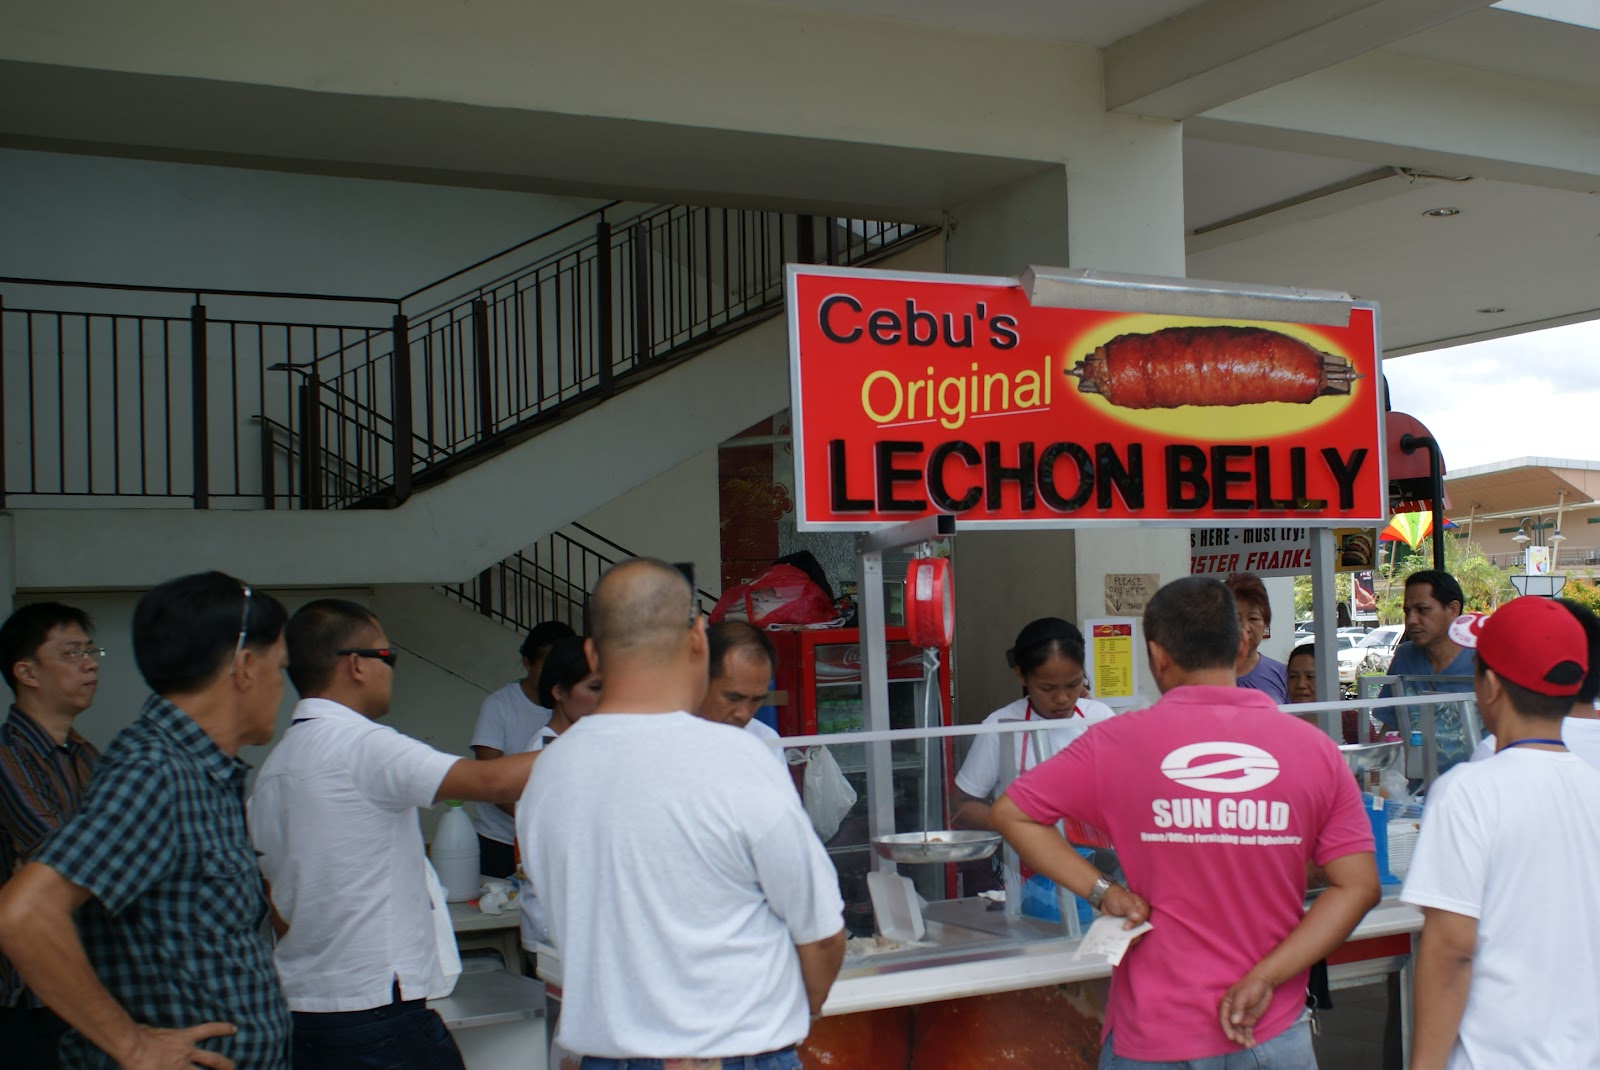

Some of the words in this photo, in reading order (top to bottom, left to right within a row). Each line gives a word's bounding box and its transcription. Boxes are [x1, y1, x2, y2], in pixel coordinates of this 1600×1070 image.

[818, 293, 1020, 349] Cebu's
[861, 356, 1052, 430] Original
[829, 439, 1144, 514] LECHON
[1164, 444, 1369, 514] BELLY
[1200, 528, 1230, 547] HERE
[1243, 528, 1276, 544] must
[1280, 528, 1305, 542] try!
[1114, 576, 1143, 586] PLEASE
[1125, 587, 1147, 597] HERE
[1152, 798, 1213, 829] SUN
[1218, 798, 1289, 830] GOLD
[1239, 836, 1256, 845] and
